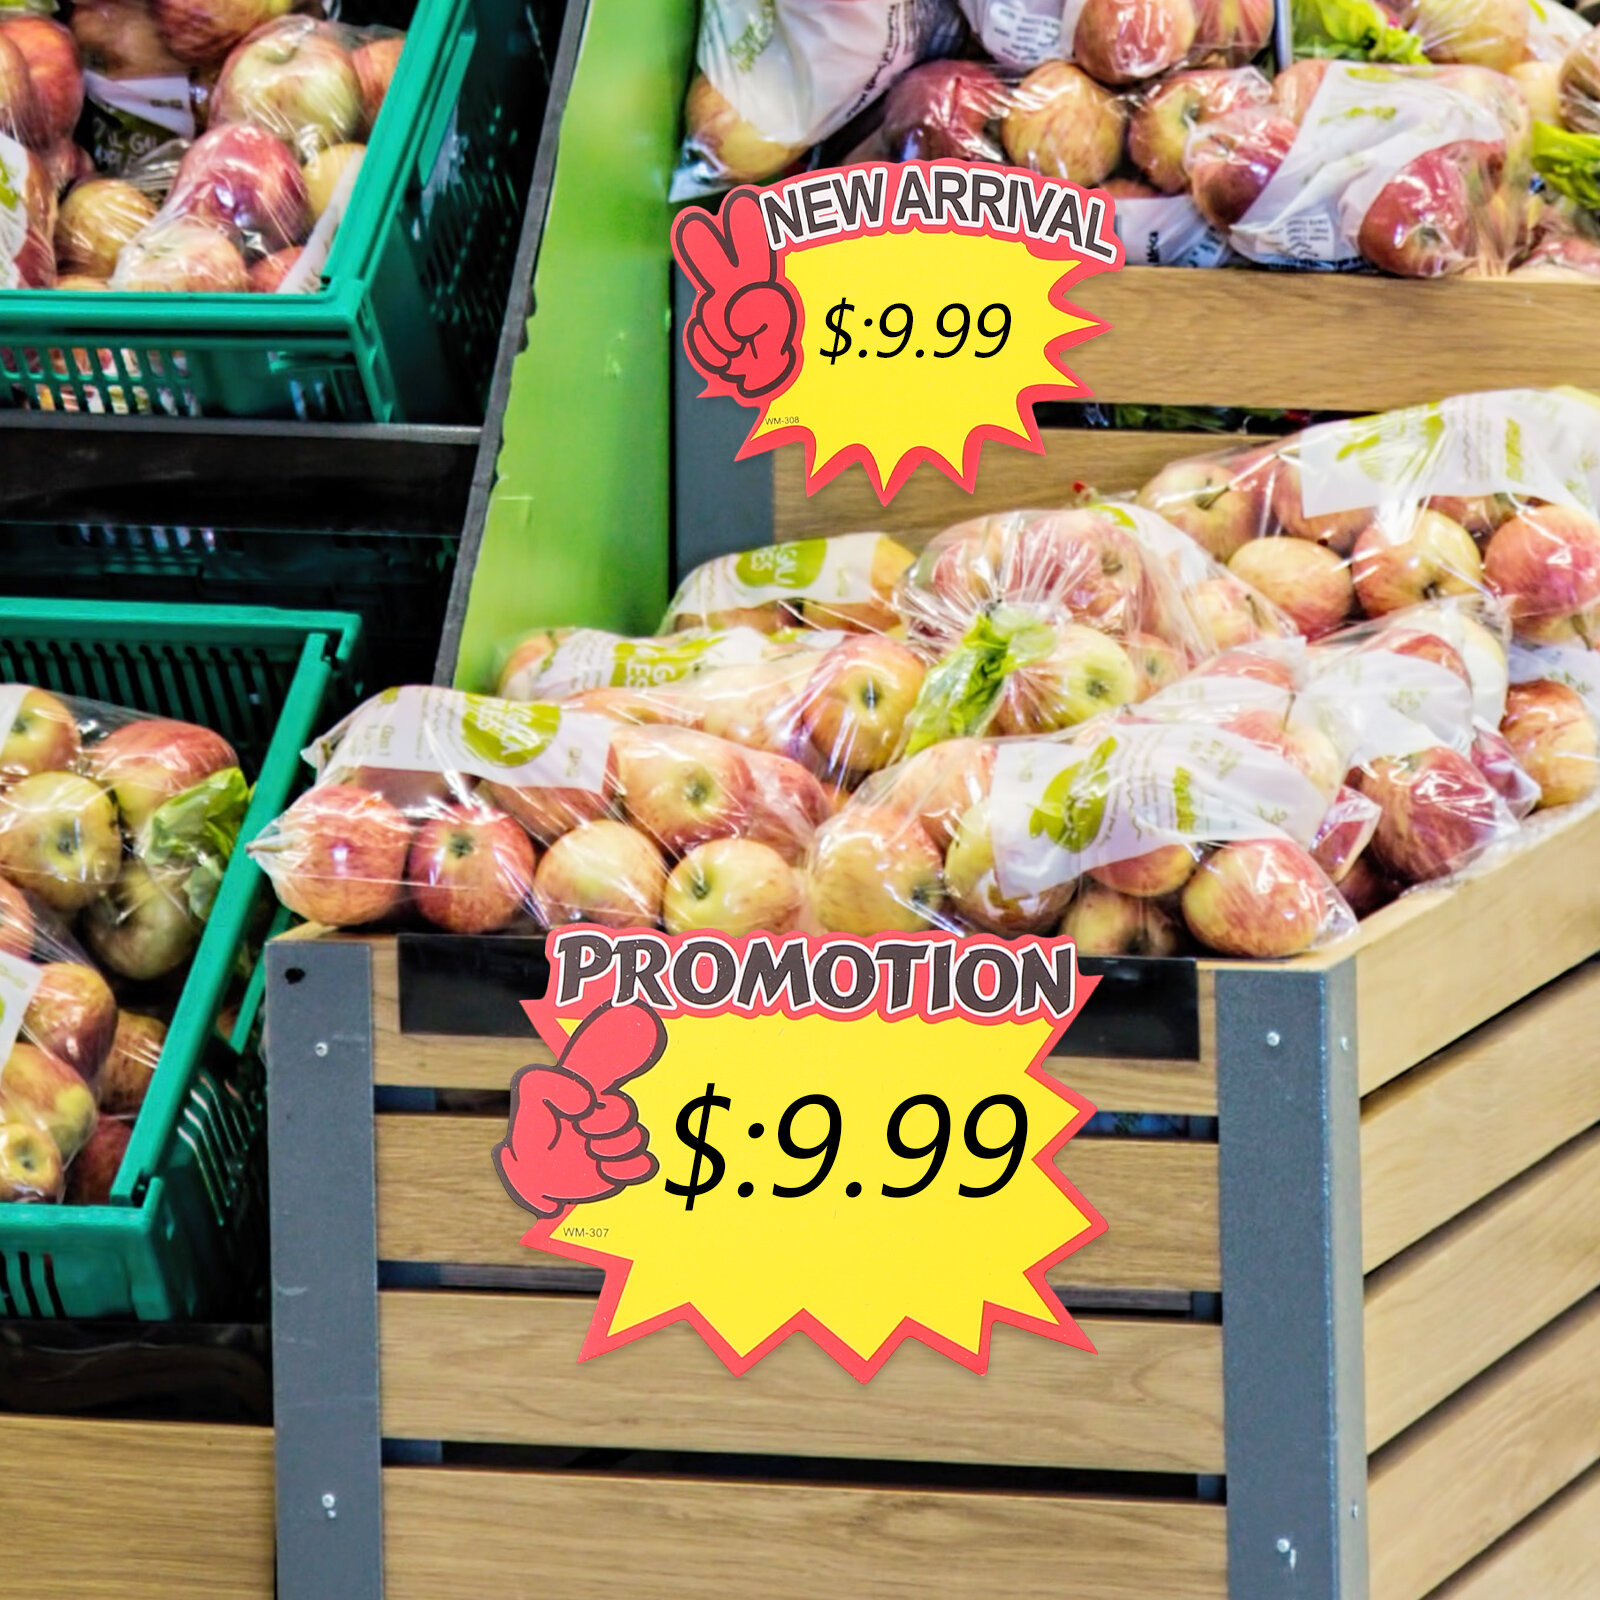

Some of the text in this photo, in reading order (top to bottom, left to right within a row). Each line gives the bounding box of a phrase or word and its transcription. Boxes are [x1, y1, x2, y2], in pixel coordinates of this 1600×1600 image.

[764, 172, 884, 246] NEW
[895, 170, 1115, 259] ARRIVAL
[819, 297, 1012, 365] $:9.99
[765, 416, 800, 426] WM-308
[557, 934, 1077, 1017] PROMOTION
[664, 1083, 1028, 1212] $:9.99
[563, 1227, 610, 1239] WM-307
